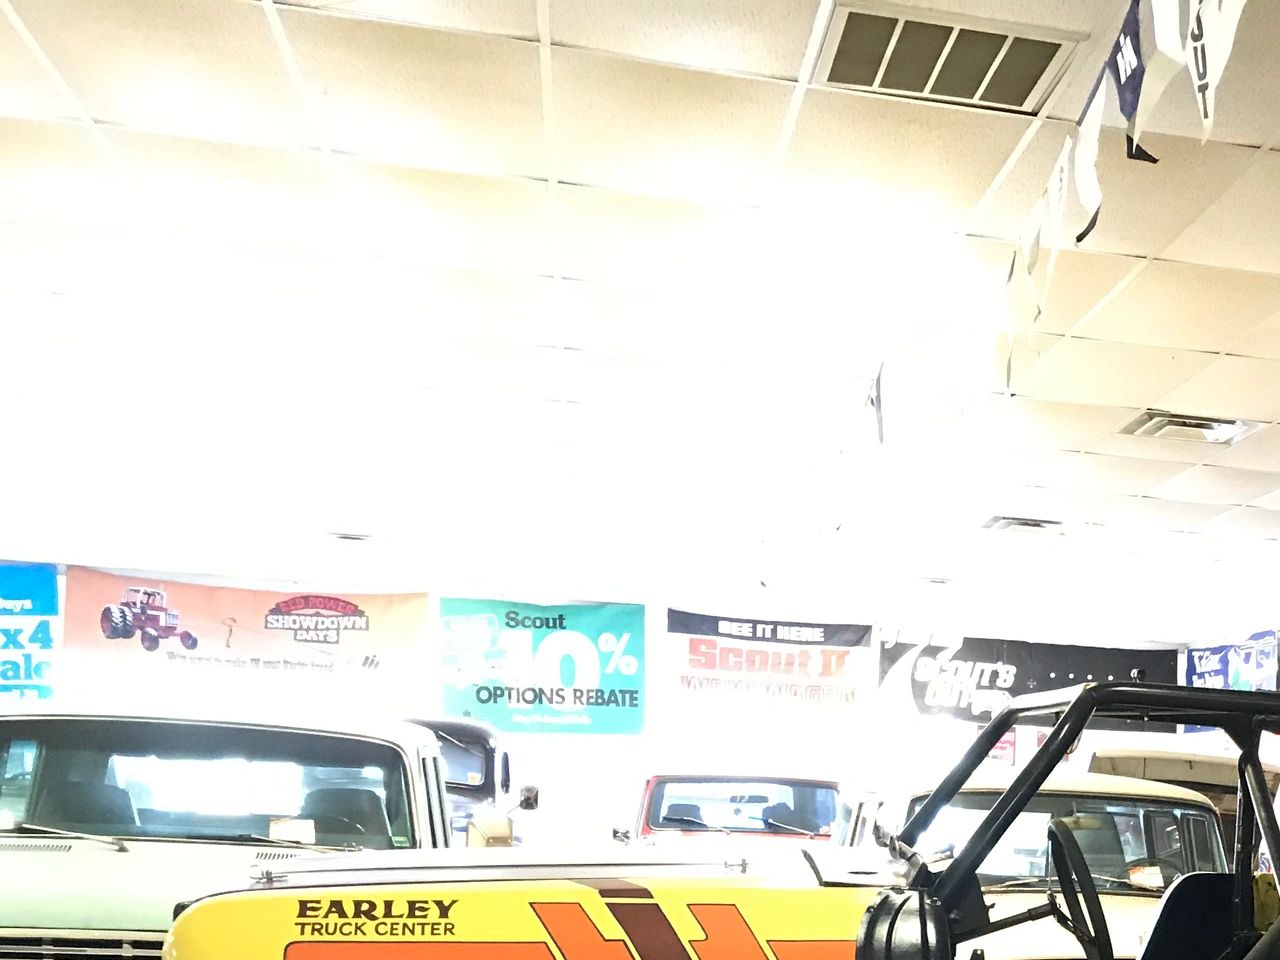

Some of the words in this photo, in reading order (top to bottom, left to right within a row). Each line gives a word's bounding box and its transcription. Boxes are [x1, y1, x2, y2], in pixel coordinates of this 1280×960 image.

[307, 598, 356, 615] POWER
[267, 614, 367, 630] SHOWDOWN
[505, 611, 567, 630] Scout
[295, 630, 338, 643] DAYS
[718, 620, 753, 637] SEE
[756, 624, 774, 639] IT
[777, 625, 825, 642] HERE
[689, 637, 812, 675] Scout
[475, 685, 565, 704] OPTIONS
[573, 689, 639, 708] REBATE
[295, 900, 459, 920] EARLEY
[295, 923, 367, 936] TRUCK
[375, 922, 457, 936] CENTER
